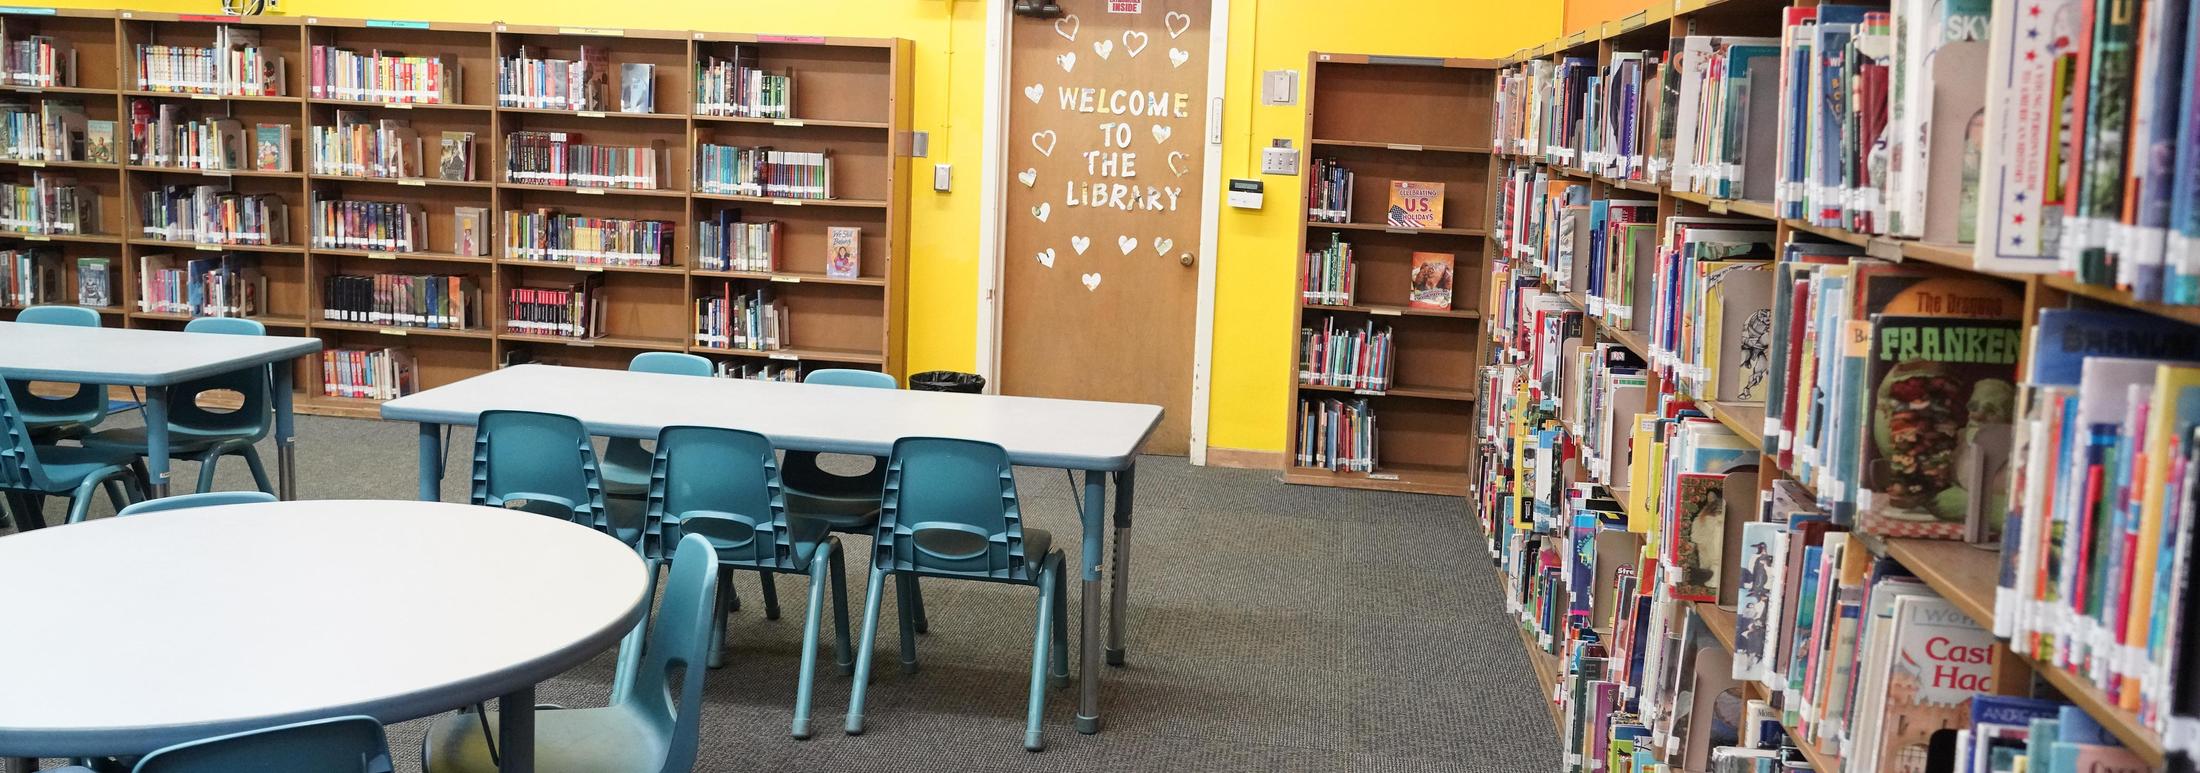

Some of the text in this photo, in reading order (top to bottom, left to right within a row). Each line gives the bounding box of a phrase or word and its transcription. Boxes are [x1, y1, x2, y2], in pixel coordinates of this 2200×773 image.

[1112, 3, 1138, 12] INSIDE
[1058, 86, 1189, 118] WELCOME
[1100, 122, 1132, 148] TO
[1083, 150, 1137, 178] THE
[1405, 197, 1432, 212] U.S.
[1403, 213, 1434, 221] HOLIDAYS
